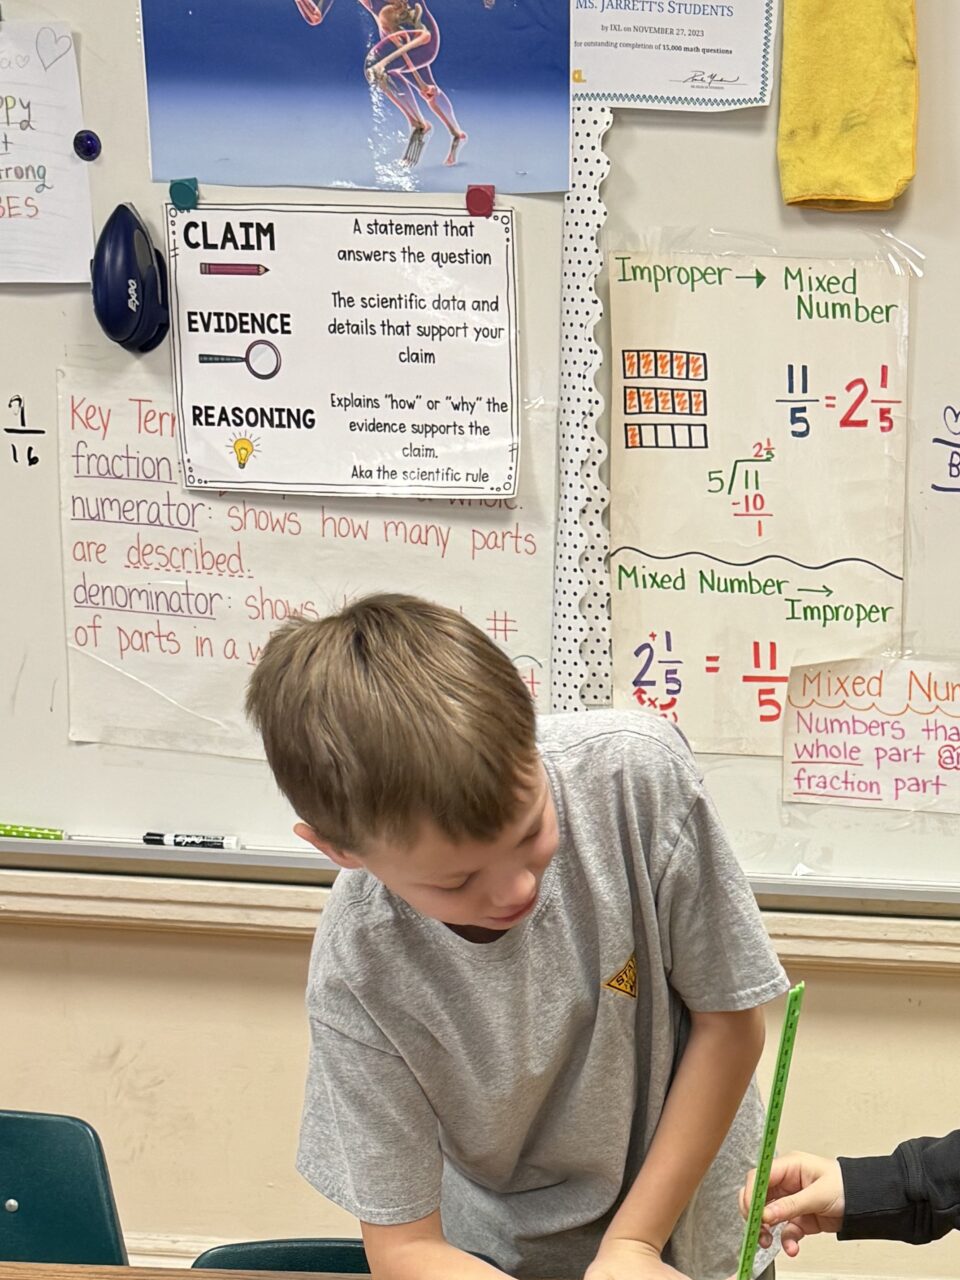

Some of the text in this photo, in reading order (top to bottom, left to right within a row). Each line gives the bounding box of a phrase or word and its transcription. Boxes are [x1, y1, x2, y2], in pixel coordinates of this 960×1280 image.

[668, 1, 734, 17] STUDENTS
[633, 26, 674, 36] NOVEMBER
[619, 42, 654, 52] completion
[183, 221, 276, 251] CLAIM
[353, 218, 475, 238] A statement that
[337, 247, 492, 268] answers the question
[614, 256, 857, 296] Improper Mixed
[331, 292, 499, 312] The scientific data and
[796, 294, 899, 324] Number
[187, 311, 292, 336] EVIDENCE
[327, 318, 505, 343] details that support your
[398, 348, 436, 364] claim
[330, 393, 509, 415] Explains "how" or "why" the
[71, 395, 112, 440] Key
[192, 405, 316, 430] REASONING
[349, 418, 491, 439] evidence supports the
[402, 444, 439, 459] claim.
[351, 466, 490, 484] Aka the scientific rule
[228, 504, 302, 538] shows
[320, 505, 370, 541] how
[383, 519, 451, 558] many
[471, 522, 538, 560] parts
[72, 542, 108, 565] are
[617, 564, 789, 596] Mixed Number
[245, 586, 320, 621] shows
[784, 598, 894, 629] Improper
[74, 620, 102, 648] of
[118, 626, 181, 660] parts
[194, 634, 214, 658] in
[223, 639, 240, 660] a
[801, 670, 883, 699] Mixed
[796, 711, 906, 740] Numbers
[793, 741, 863, 762] whole
[874, 744, 926, 773] part
[793, 768, 948, 801] fraction part
